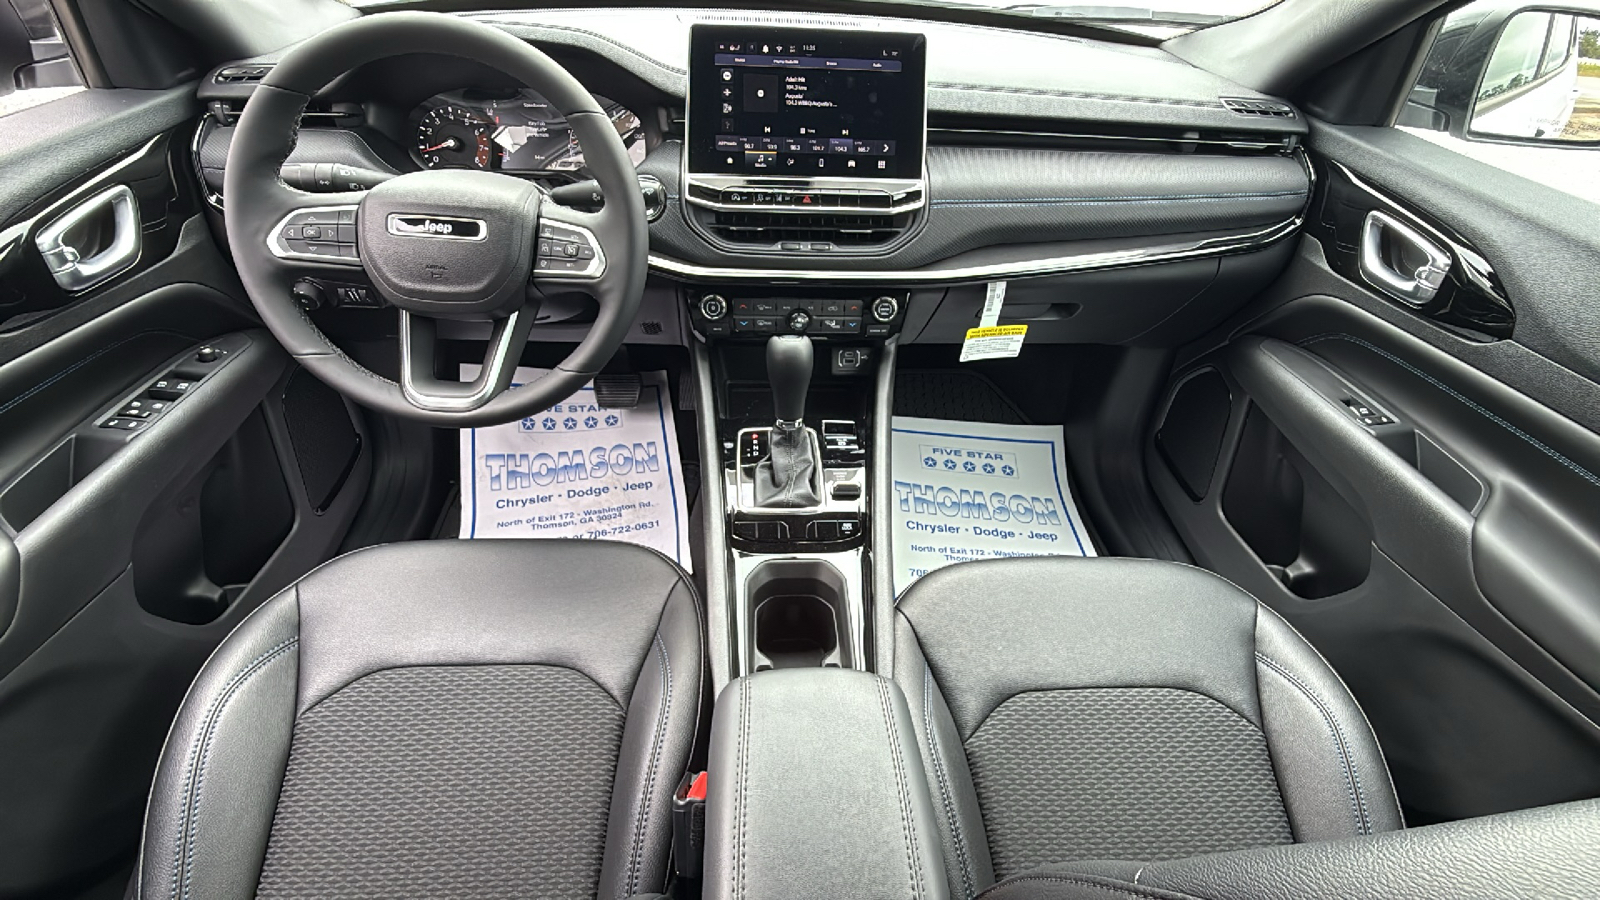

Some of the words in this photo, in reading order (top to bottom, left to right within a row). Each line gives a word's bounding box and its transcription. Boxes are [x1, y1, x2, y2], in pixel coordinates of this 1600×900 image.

[434, 117, 441, 125] 3
[474, 156, 480, 164] 8
[423, 219, 453, 234] Jeep
[932, 447, 963, 457] FIVE
[966, 450, 1004, 461] STAR
[485, 441, 660, 491] THOMSON
[496, 493, 553, 510] Chrysler
[567, 485, 610, 499] Dodge
[623, 480, 653, 492] Jeep
[894, 480, 1062, 525] THOMSON
[497, 519, 523, 528] North
[526, 515, 536, 524] of
[538, 514, 556, 523] Exit
[559, 512, 575, 520] 172
[583, 503, 636, 517] Washington
[531, 520, 577, 531] Thomson,
[580, 516, 594, 524] GA
[587, 520, 660, 539] 706-722-0631
[906, 520, 960, 535] Chrysler
[973, 526, 1016, 540] Dodge
[1027, 531, 1058, 542] Jeep
[911, 544, 935, 553] North
[938, 546, 948, 554] of
[950, 547, 967, 555] Exit
